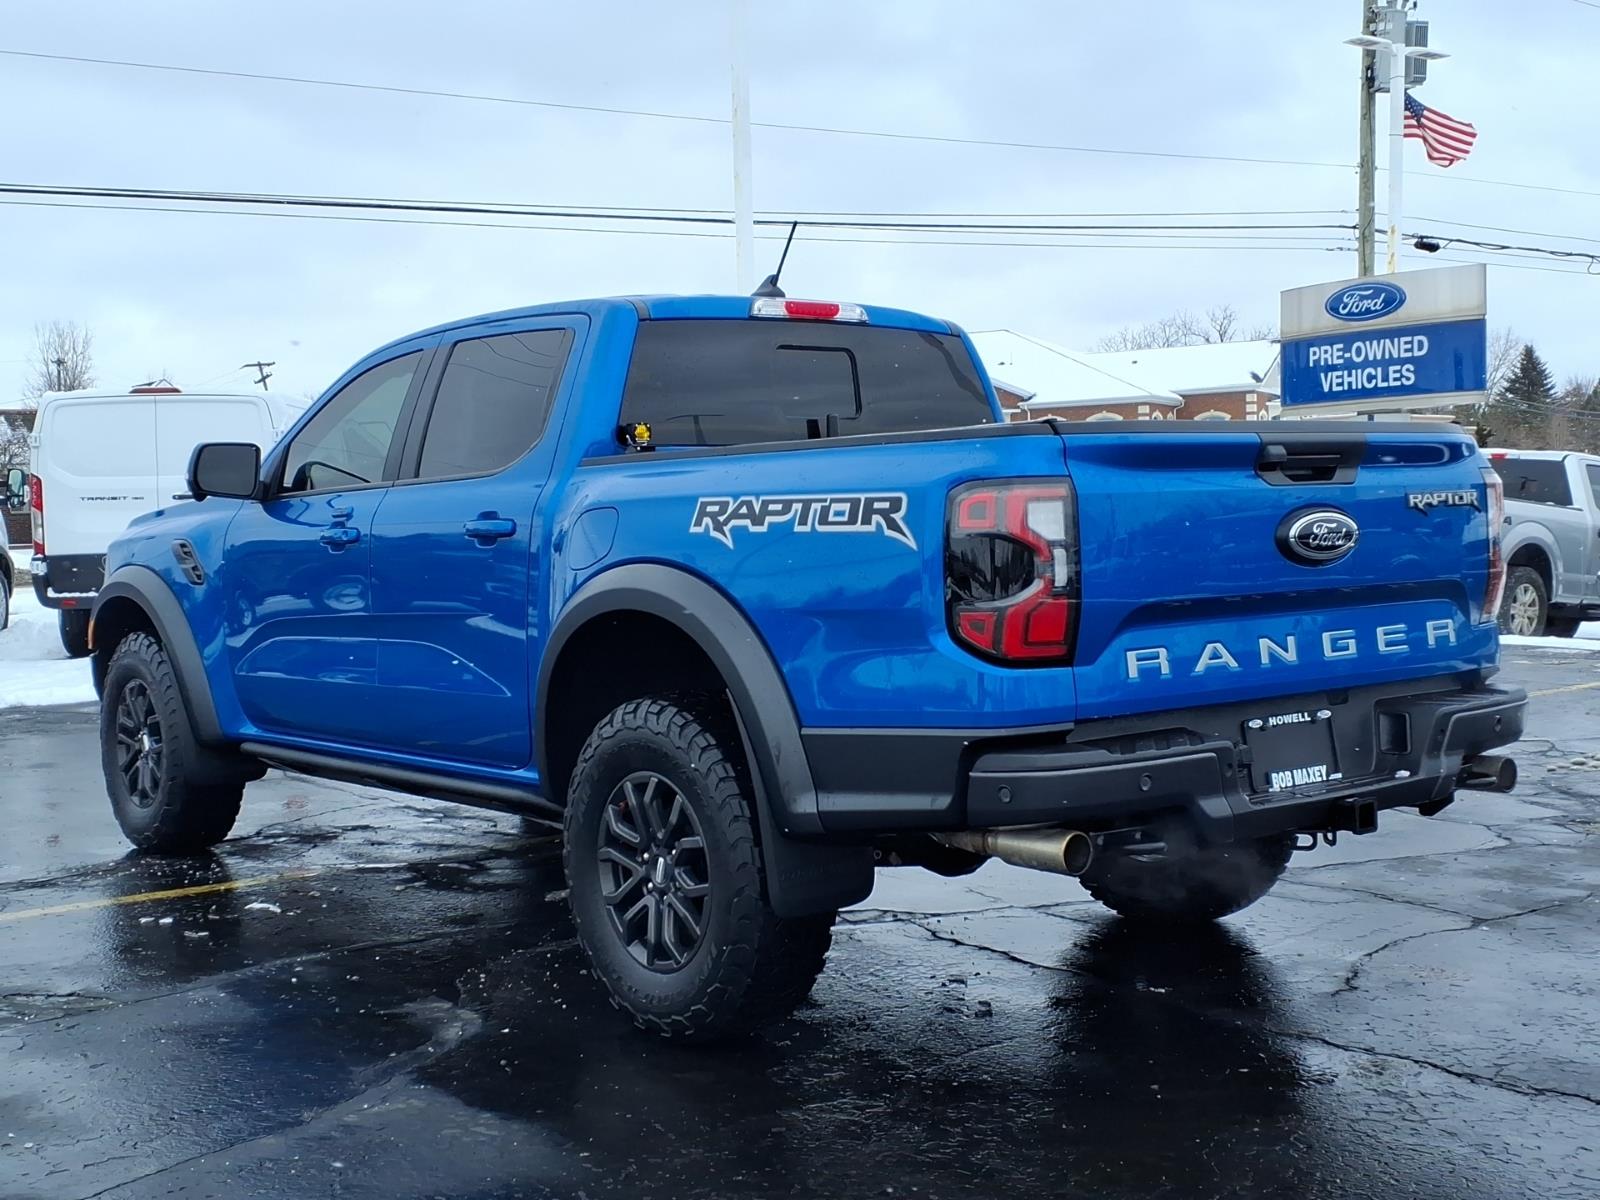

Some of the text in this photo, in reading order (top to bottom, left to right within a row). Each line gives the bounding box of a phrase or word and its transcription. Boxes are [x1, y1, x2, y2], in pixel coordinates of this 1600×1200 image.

[1339, 289, 1385, 314] Ford
[1309, 335, 1429, 367] PRE-OWNED
[1320, 364, 1415, 392] VEHICLES
[1408, 491, 1480, 511] RAPTOR
[689, 492, 918, 550] RAPTOR
[1310, 522, 1347, 547] Ford
[1126, 618, 1458, 679] RANGER
[1268, 712, 1311, 726] HOWELL
[1271, 765, 1327, 789] BOB MAXEY
